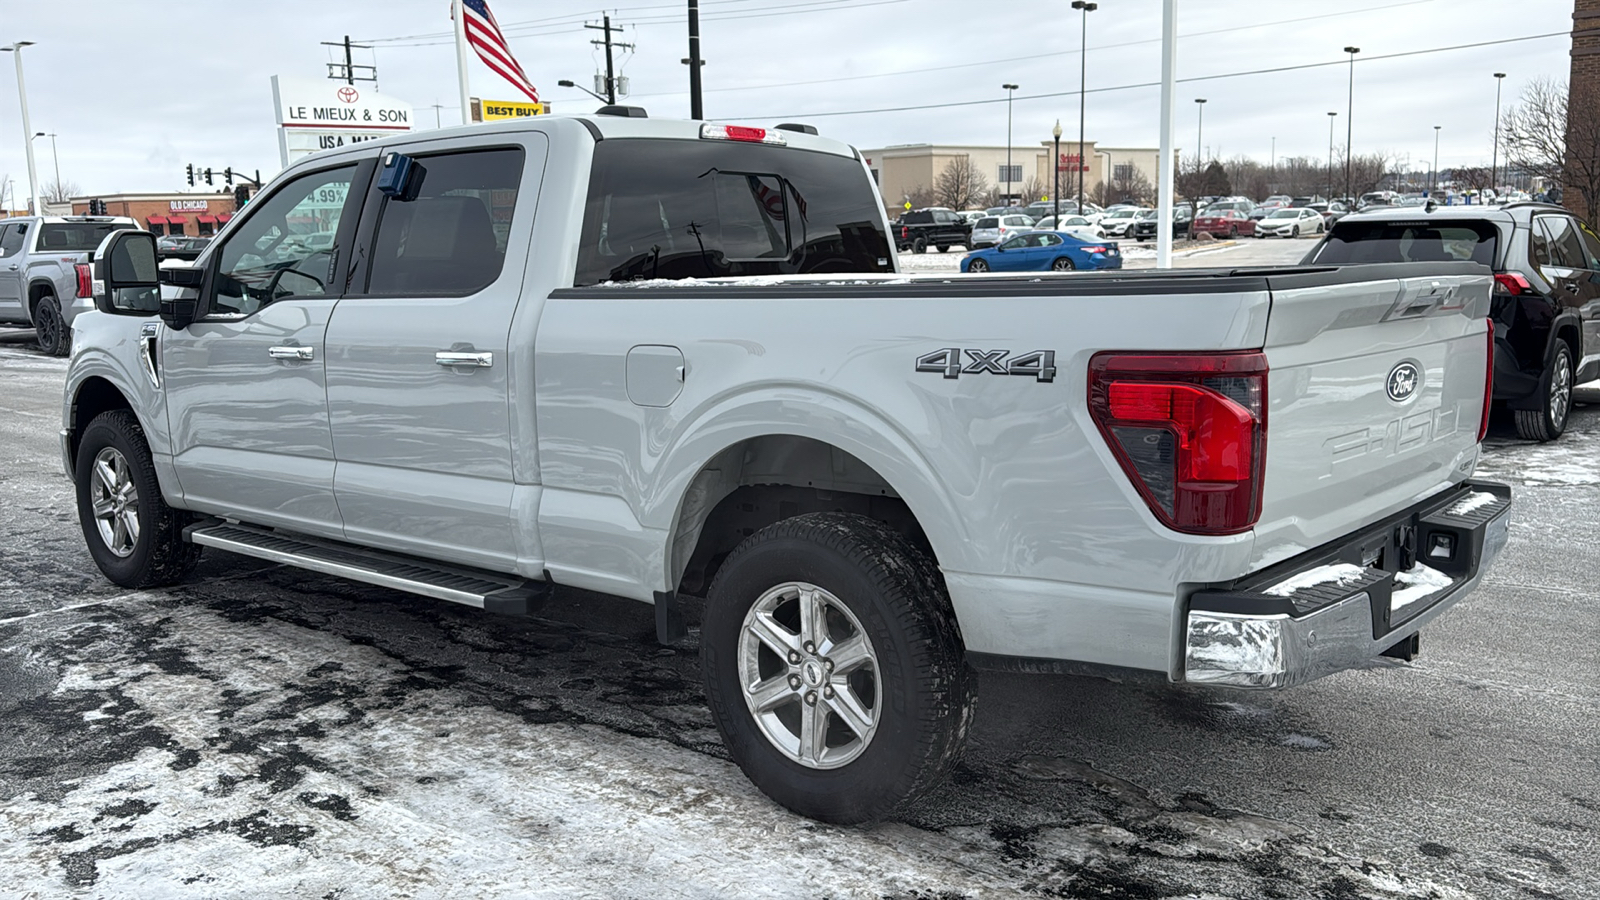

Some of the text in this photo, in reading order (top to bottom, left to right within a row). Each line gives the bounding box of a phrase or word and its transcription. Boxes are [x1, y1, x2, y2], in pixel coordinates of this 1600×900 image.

[289, 106, 408, 122] LE MIEUX & SON
[486, 106, 540, 117] BEST BUY
[319, 135, 344, 149] USA
[307, 189, 344, 203] 4.99%
[170, 200, 208, 210] OLD CHICAGO
[1391, 367, 1418, 396] Ford
[1318, 403, 1461, 481] F-150
